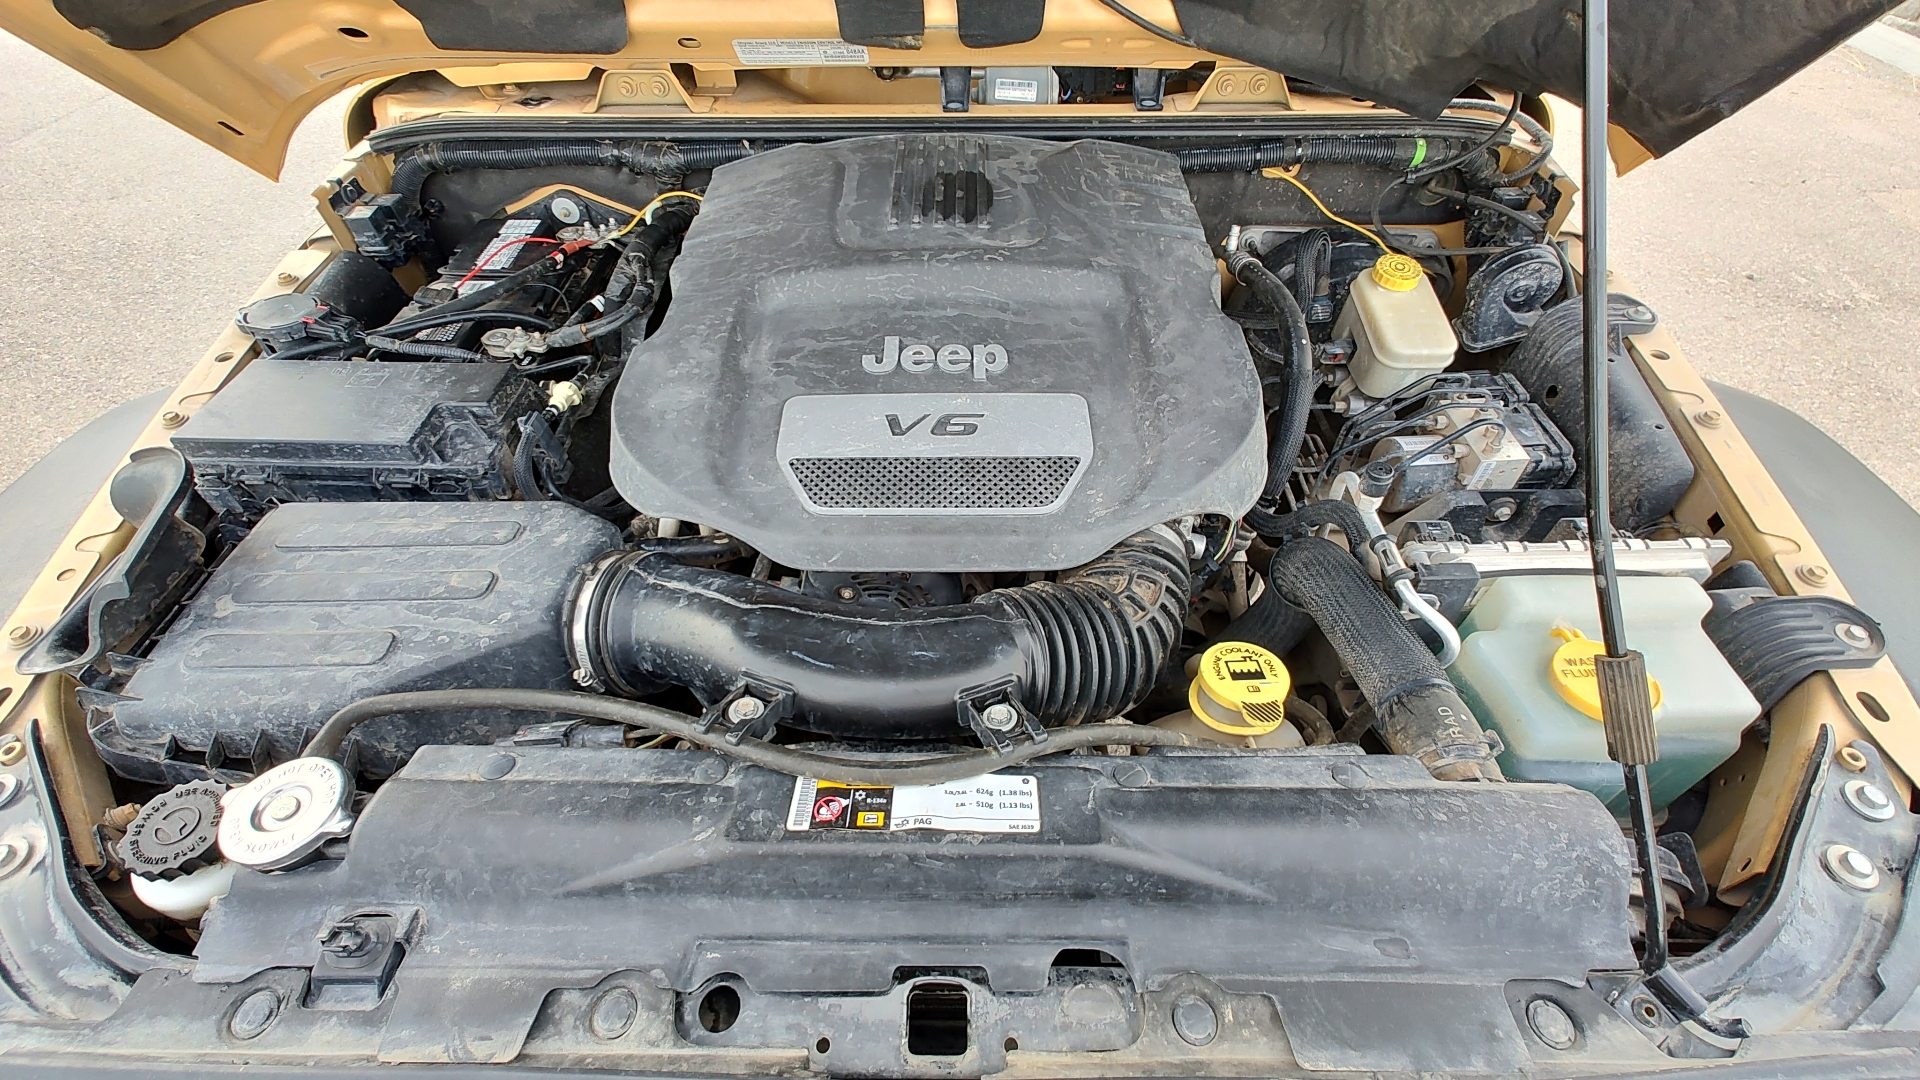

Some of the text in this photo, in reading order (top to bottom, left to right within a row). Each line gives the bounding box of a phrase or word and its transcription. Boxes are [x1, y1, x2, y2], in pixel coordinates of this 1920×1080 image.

[861, 335, 1008, 381] Jeep
[885, 413, 985, 436] V6
[1213, 647, 1279, 681] ENGINE COOLANT ONLY
[1563, 656, 1595, 667] WAS
[1437, 706, 1465, 738] RAD
[175, 787, 200, 799] USE
[975, 788, 994, 797] 624g
[998, 789, 1018, 797] (1.38
[1019, 789, 1033, 797] lbs)
[975, 801, 994, 810] 510g
[998, 802, 1018, 810] (1.13
[1019, 802, 1033, 810] lbs)
[132, 799, 168, 836] POWER
[173, 835, 208, 861] FLUID
[913, 817, 933, 826] PAG
